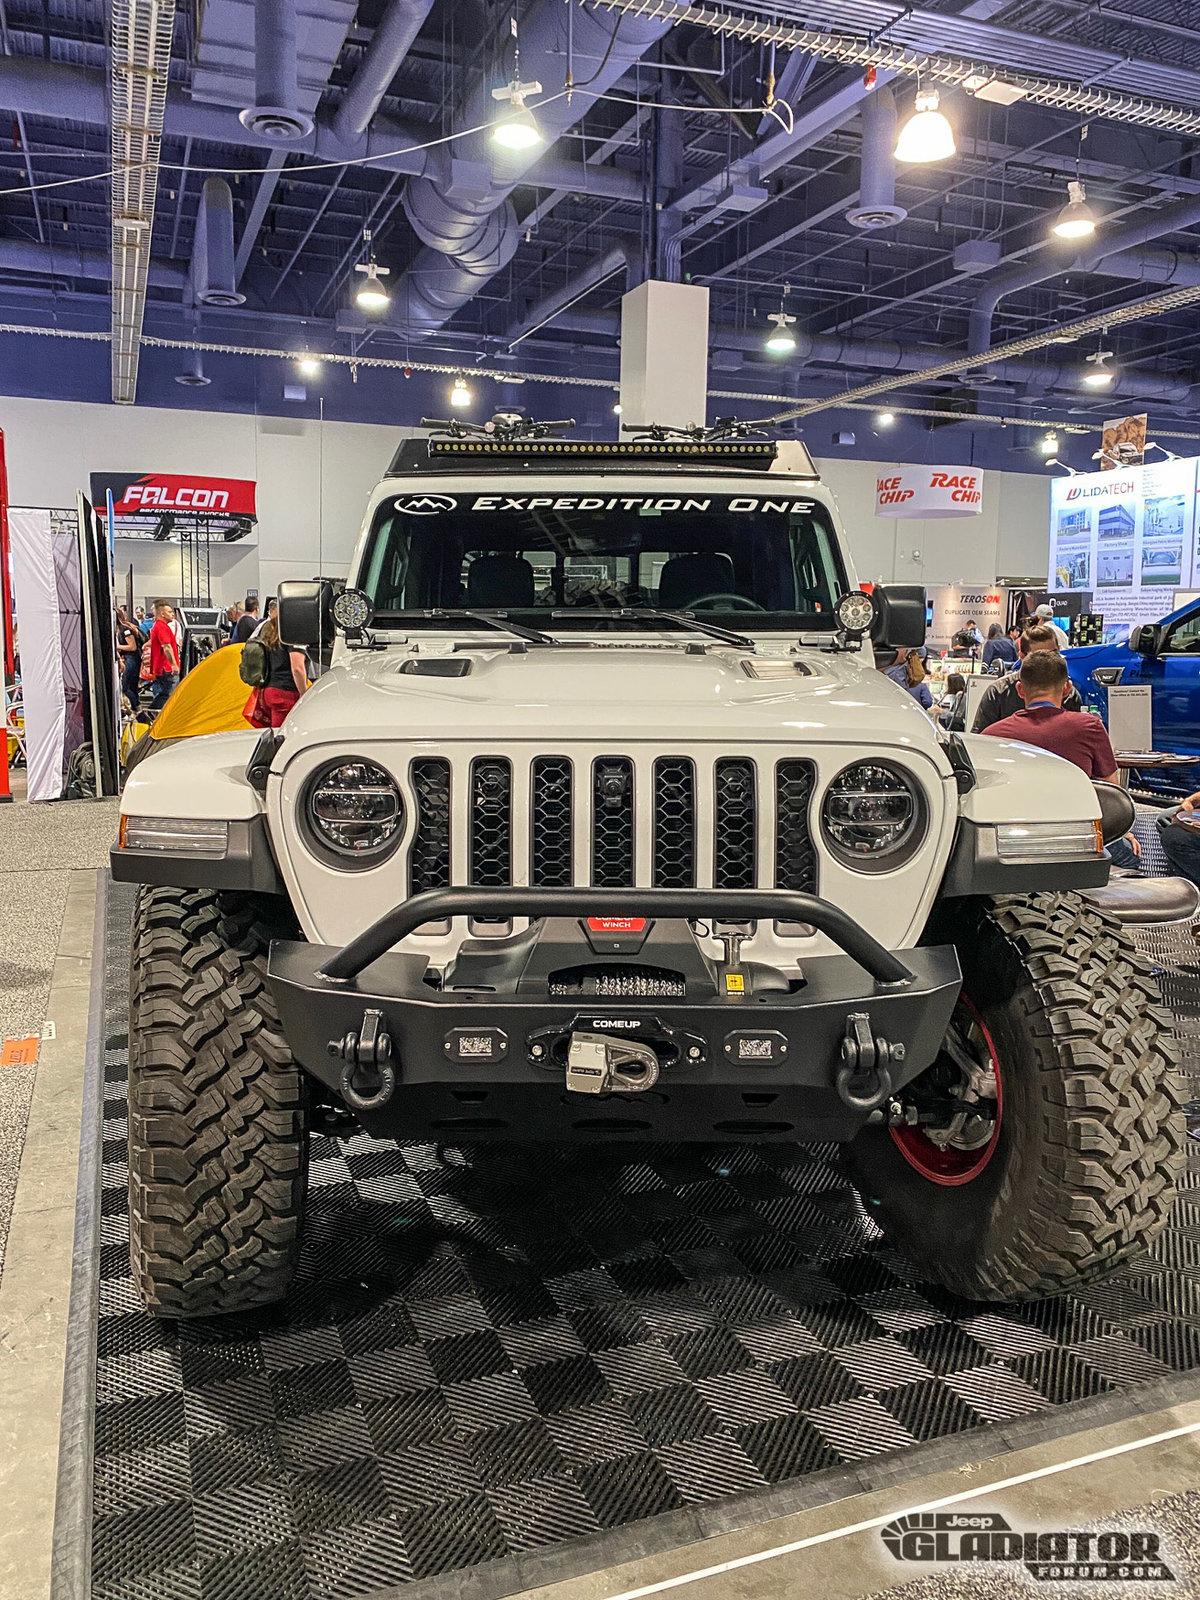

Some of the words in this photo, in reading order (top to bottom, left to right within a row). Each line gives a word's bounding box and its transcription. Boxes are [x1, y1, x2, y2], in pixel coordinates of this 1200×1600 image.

[930, 473, 976, 489] RACE
[123, 486, 229, 508] FALCON
[880, 490, 915, 504] CHIP
[951, 490, 981, 503] CHIP
[1083, 482, 1134, 498] LIDATECH
[960, 595, 1000, 604] TEROSON
[592, 1020, 641, 1028] COMEUP
